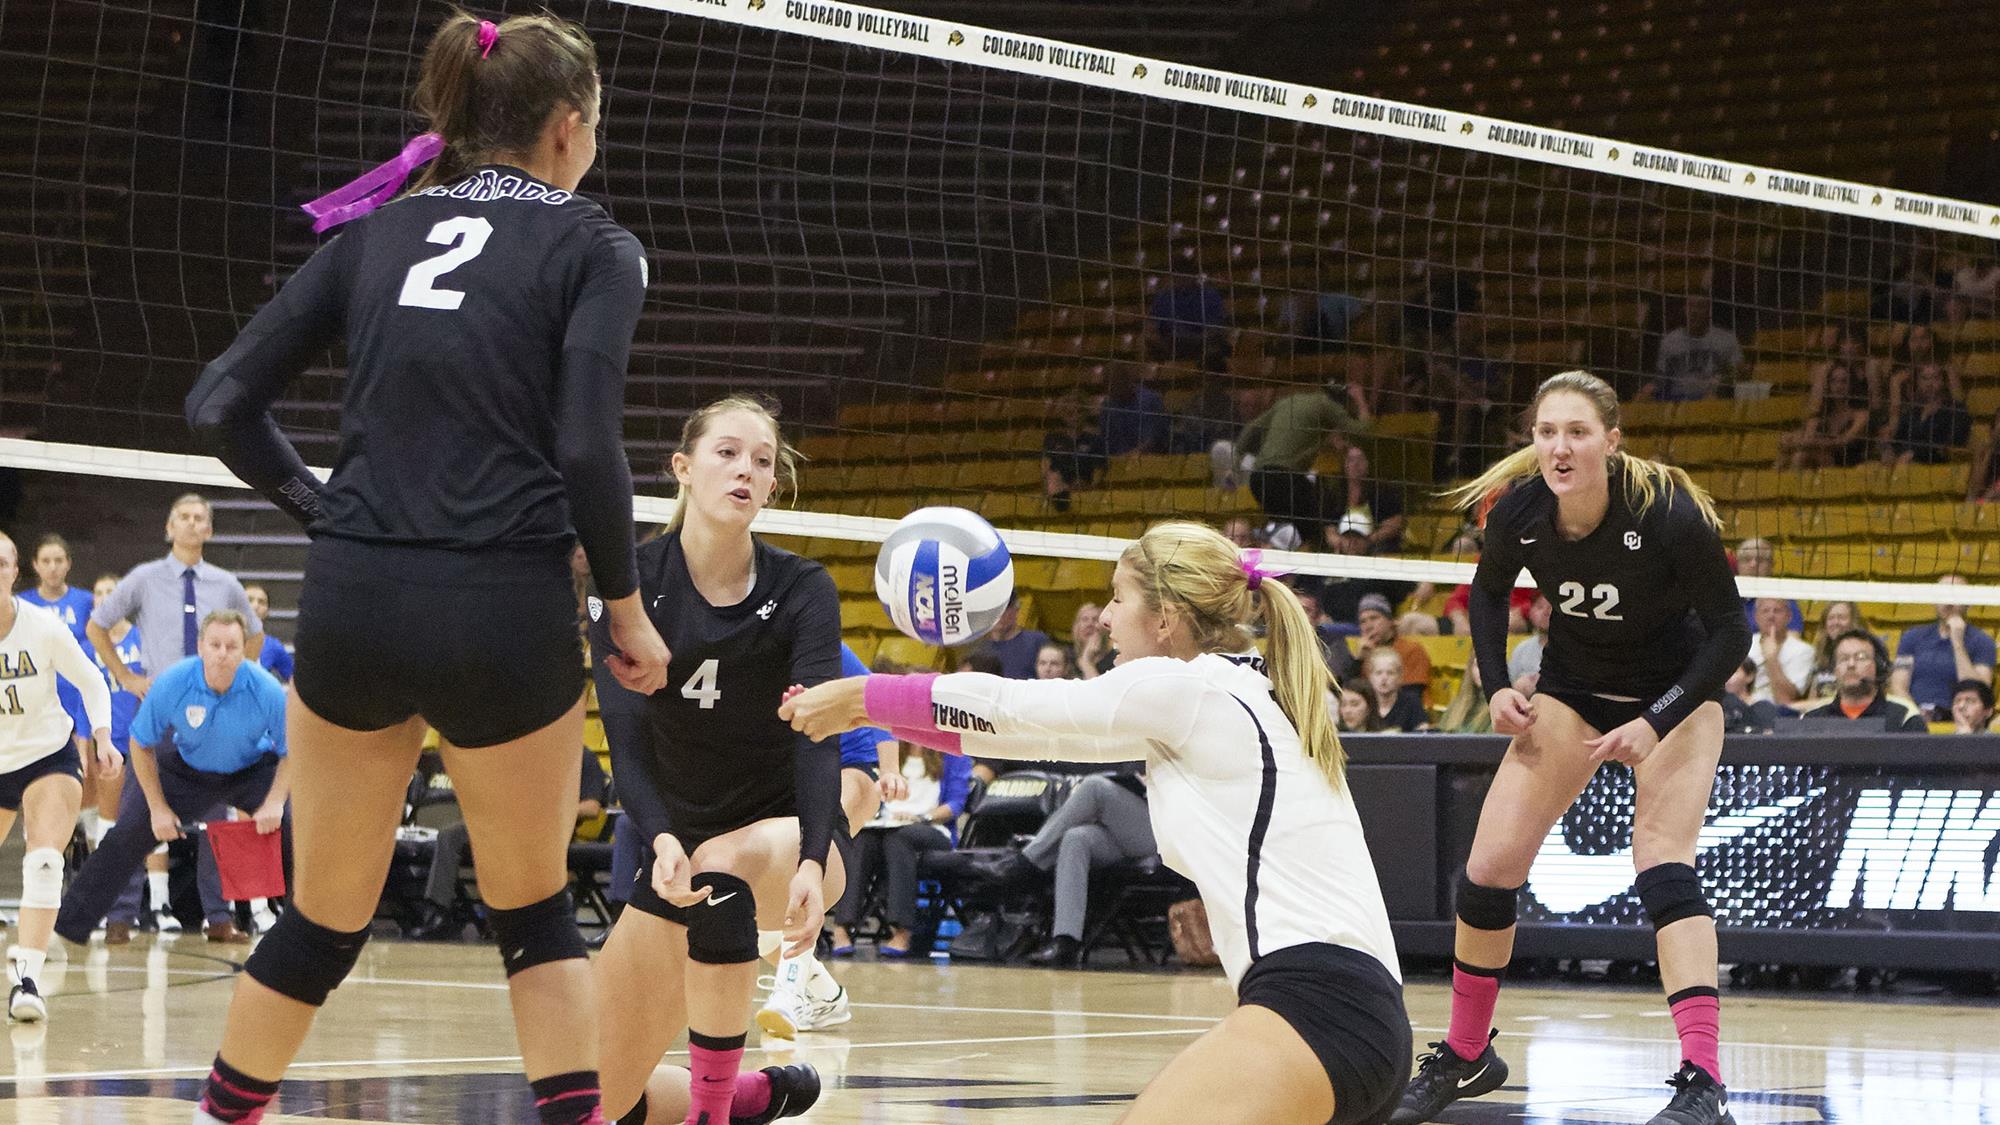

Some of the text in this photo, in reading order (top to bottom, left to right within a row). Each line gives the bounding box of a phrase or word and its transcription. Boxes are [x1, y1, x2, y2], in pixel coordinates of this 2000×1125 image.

[785, 0, 929, 42] COLORADO VOLLEYBALL
[983, 35, 1115, 76] COLORADO VOLLEYBALL
[1164, 68, 1287, 106] COLORADO VOLLEYBALL
[1332, 97, 1446, 132] COLORADO VOLLEYBALL
[1487, 125, 1594, 158] COLORADO VOLLEYBALL
[1632, 151, 1732, 183] COLORADO VOLLEYBALL
[1767, 175, 1860, 204] COLORADO VOLLEYBALL
[1894, 196, 1980, 223] COLORADO VOLLEYBALL
[398, 216, 494, 310] 2
[943, 565, 963, 636] molten
[1559, 581, 1623, 620] 22
[0, 684, 24, 715] 1
[681, 659, 721, 709] 4
[932, 702, 996, 735] COLORA
[1824, 789, 2000, 912] NIK
